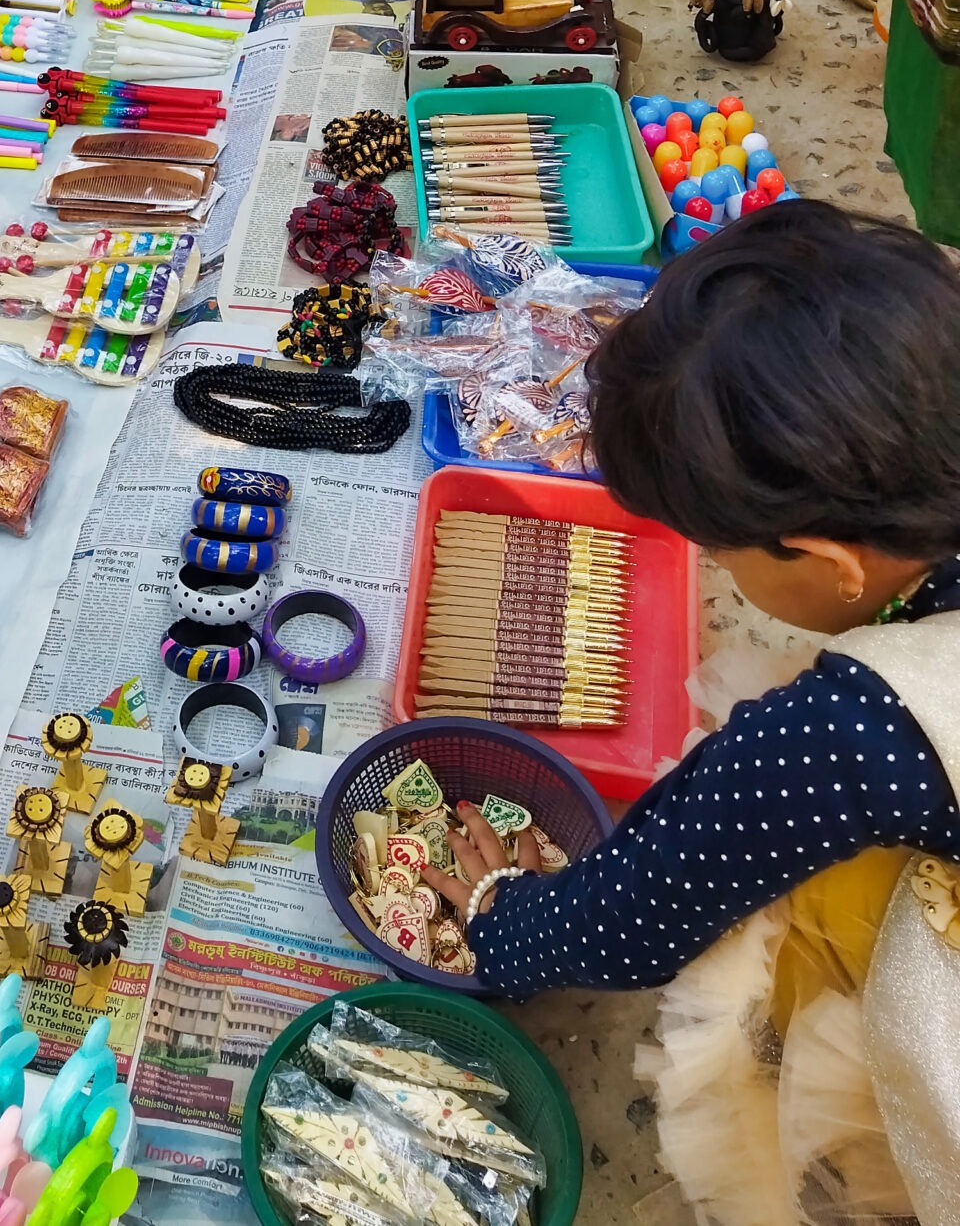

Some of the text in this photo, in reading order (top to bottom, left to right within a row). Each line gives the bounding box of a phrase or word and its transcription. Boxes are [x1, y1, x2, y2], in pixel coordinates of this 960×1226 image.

[308, 170, 336, 182] MODI'S
[195, 348, 233, 363] জি-২০
[311, 476, 349, 488] পুতিনকে
[294, 563, 400, 593] জিএসটির এক হারের দাবি
[11, 759, 58, 775] দেশের নাম
[115, 762, 141, 775] ব্যবস্থা
[393, 847, 411, 866] S
[260, 863, 315, 883] INSTITUTE
[182, 886, 278, 913] Mechanical Engineering (120)
[184, 880, 215, 893] Computer
[248, 893, 288, 908] Engineering
[290, 904, 304, 912] (60)
[197, 897, 234, 909] Engineering
[180, 897, 266, 922] Electrical Engineering (60)
[178, 903, 214, 918] Electronics
[221, 913, 273, 930] Communication
[275, 926, 316, 941] Engineering
[318, 936, 333, 944] (60)
[397, 928, 418, 951] B
[229, 943, 296, 970] ইনস্টিটিউট
[300, 964, 324, 977] অফ
[45, 965, 57, 977] OB
[112, 980, 146, 994] OURSES
[118, 962, 151, 979] OPEN
[36, 980, 73, 995] PATHO
[30, 1002, 59, 1017] X-Ray,
[62, 1010, 85, 1024] ECG,
[125, 1013, 139, 1021] DPT
[26, 1014, 89, 1036] O.T.Technicia
[36, 1029, 83, 1046] Class Onli
[49, 1050, 70, 1060] Comm
[53, 1043, 127, 1064] Qualifi 2th
[133, 1095, 173, 1111] Admission
[175, 1105, 207, 1118] Helpline
[182, 1118, 241, 1136] www.mipbishnup
[172, 1174, 223, 1190] More Comfort
